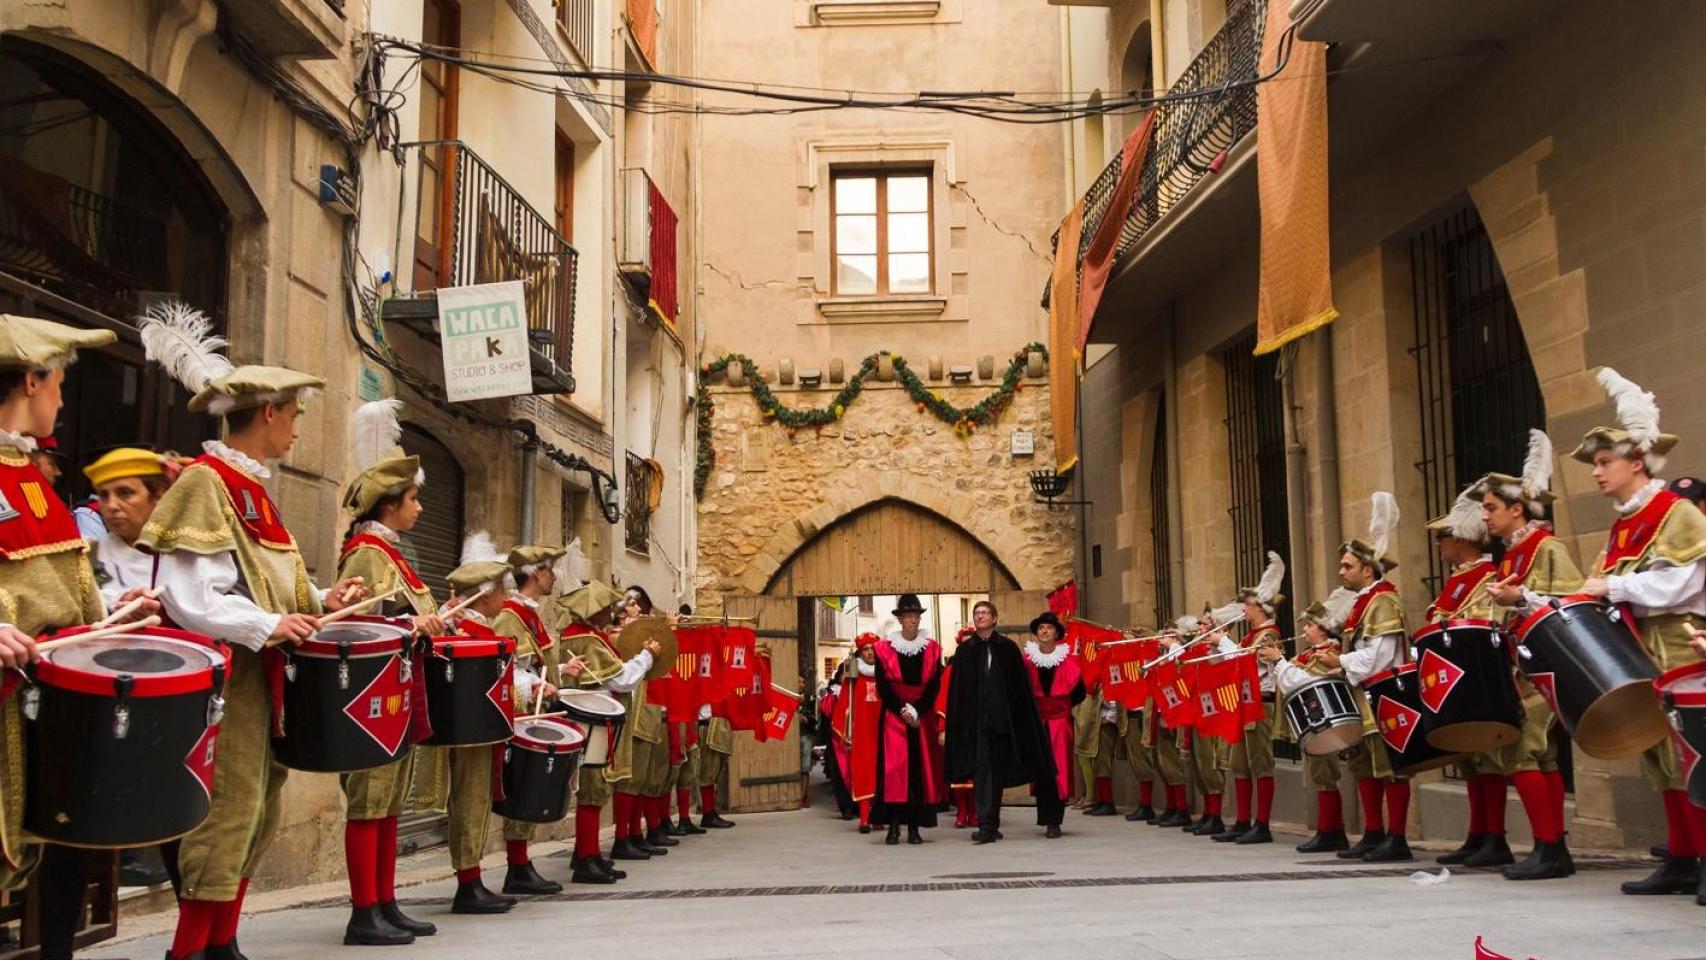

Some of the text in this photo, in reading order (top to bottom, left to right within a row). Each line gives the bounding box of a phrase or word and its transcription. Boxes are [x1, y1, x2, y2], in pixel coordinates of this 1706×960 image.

[452, 360, 526, 380] STUDIO & SHOP
